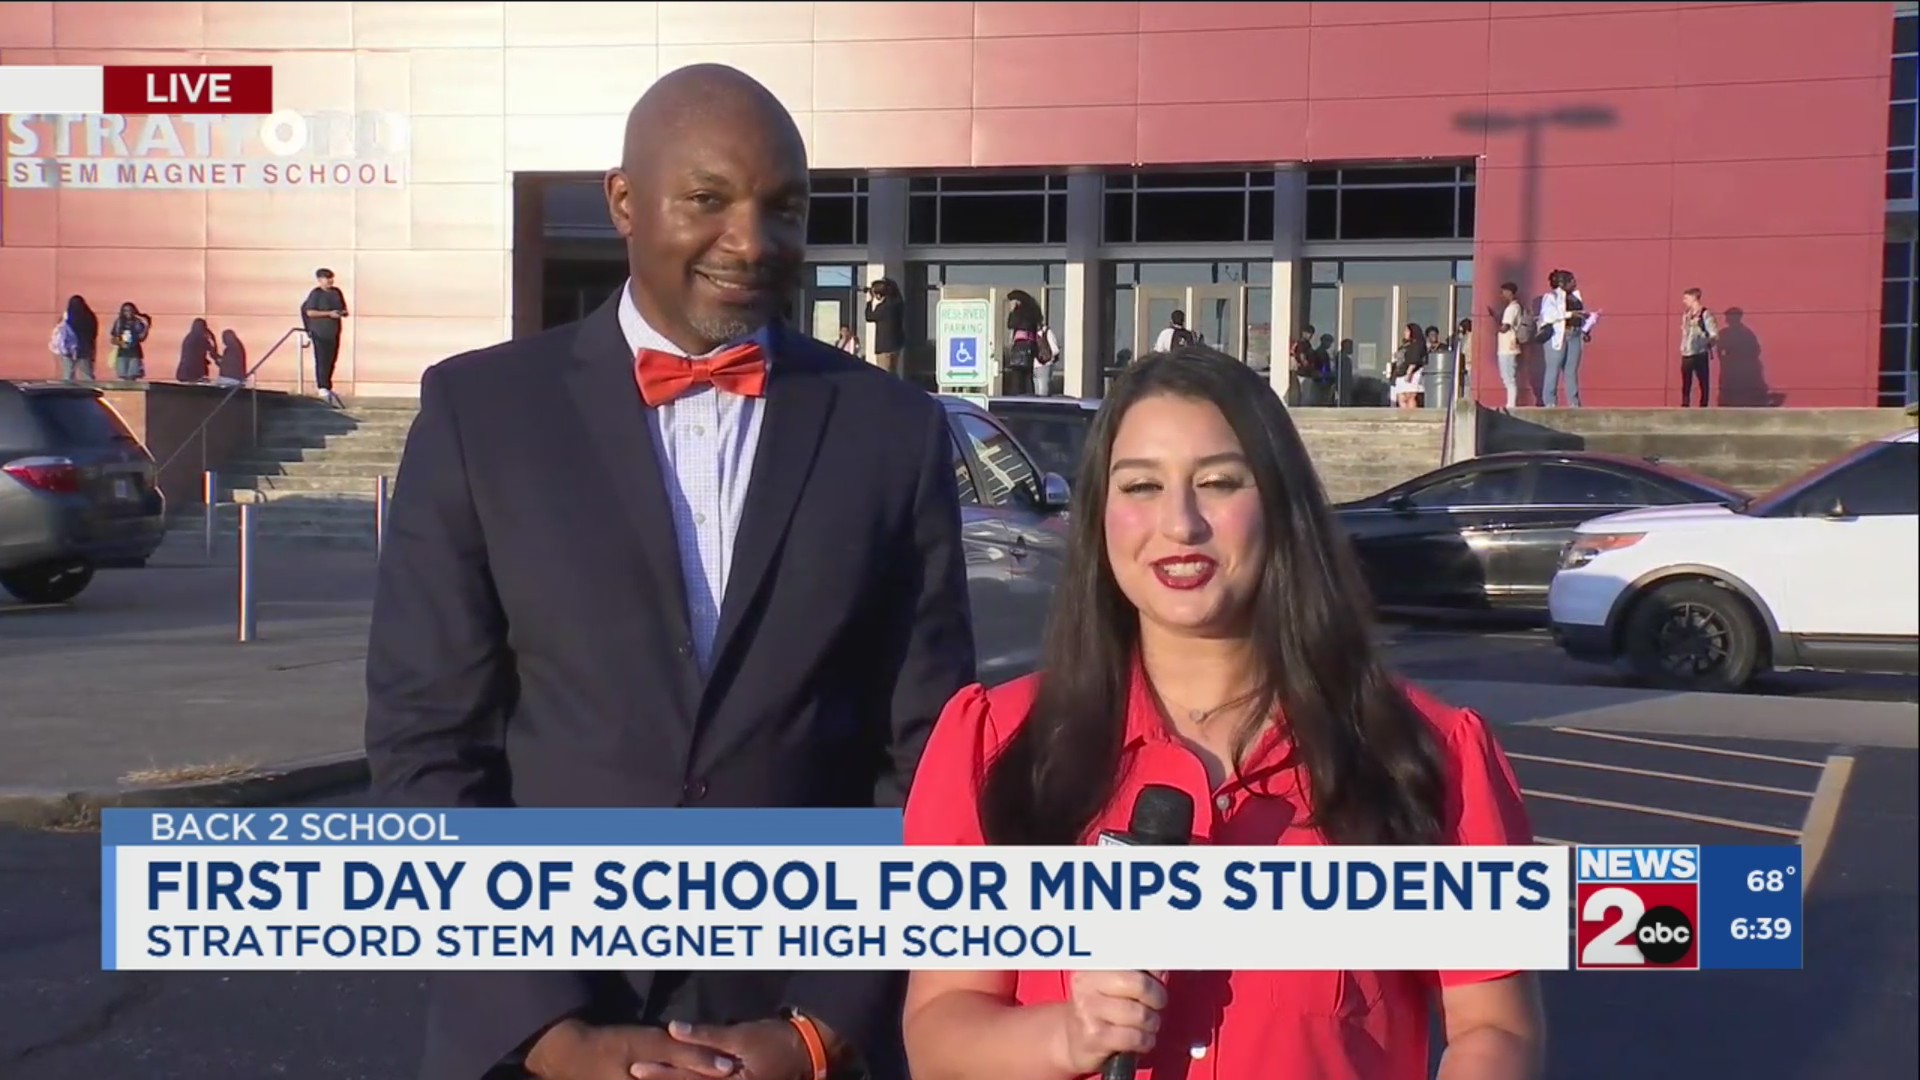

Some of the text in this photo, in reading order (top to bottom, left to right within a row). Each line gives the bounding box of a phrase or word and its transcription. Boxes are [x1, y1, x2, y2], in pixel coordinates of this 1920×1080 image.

[13, 162, 398, 185] STEM MAGNET SCHOOL
[942, 308, 986, 320] RESERVED
[944, 322, 983, 334] PARKING
